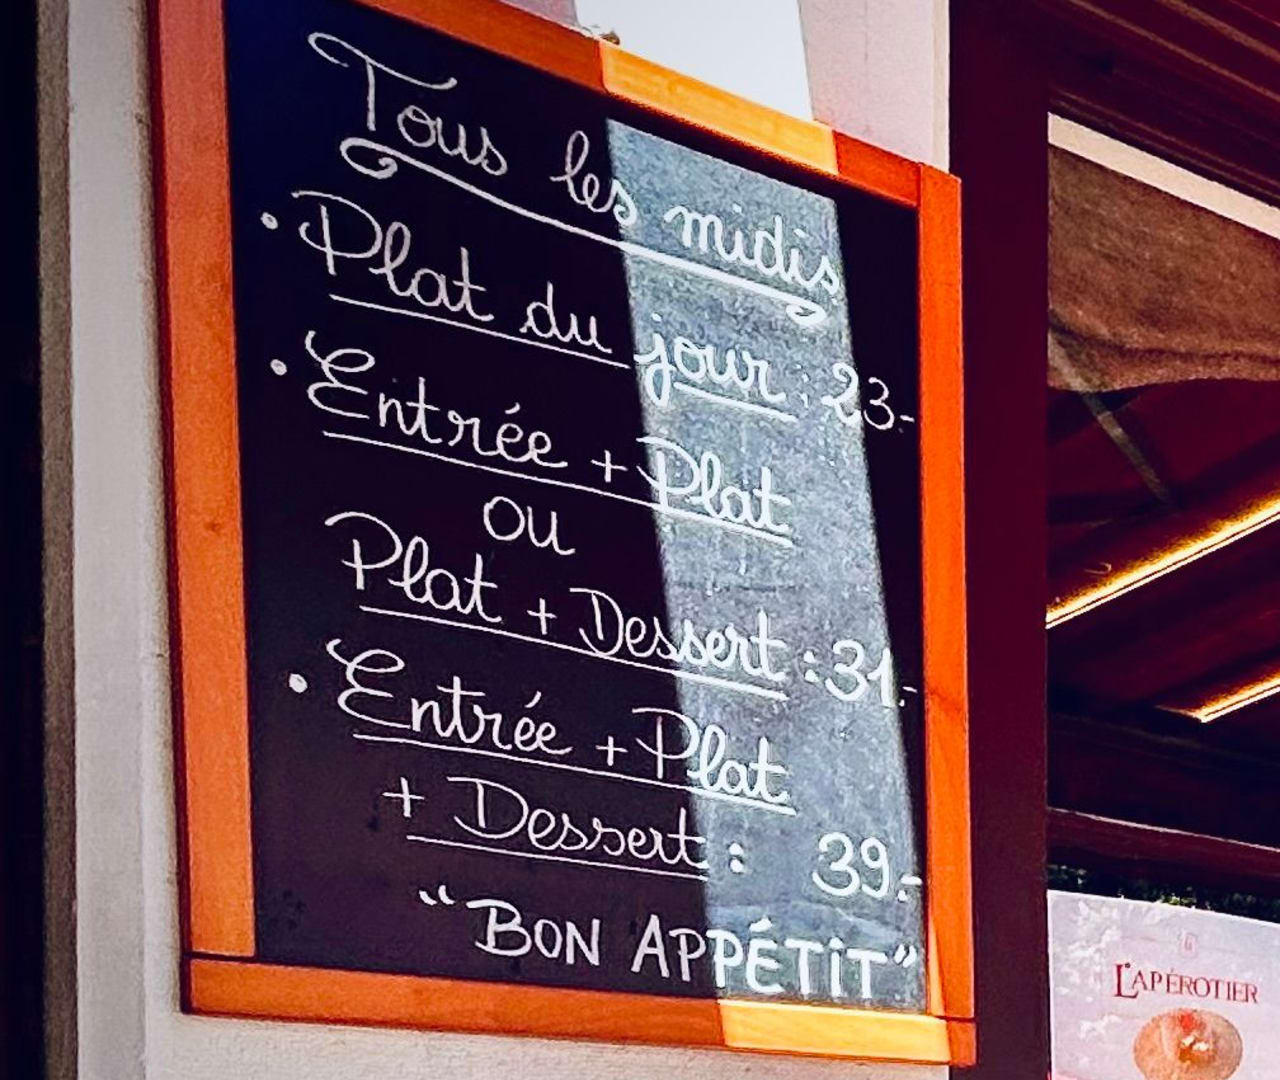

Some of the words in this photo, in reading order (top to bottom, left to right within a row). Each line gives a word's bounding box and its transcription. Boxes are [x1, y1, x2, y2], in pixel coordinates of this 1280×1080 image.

[308, 31, 507, 176] Tous
[551, 131, 638, 223] les
[665, 205, 841, 297] midis
[291, 191, 495, 321] Plat
[520, 281, 613, 354] du
[633, 313, 785, 404] jour
[306, 331, 568, 469] Entrée
[637, 436, 792, 532] Plat
[324, 511, 503, 624] Plat
[569, 587, 787, 681] Dessert
[326, 639, 572, 755] Entrée
[632, 706, 791, 803] Plat
